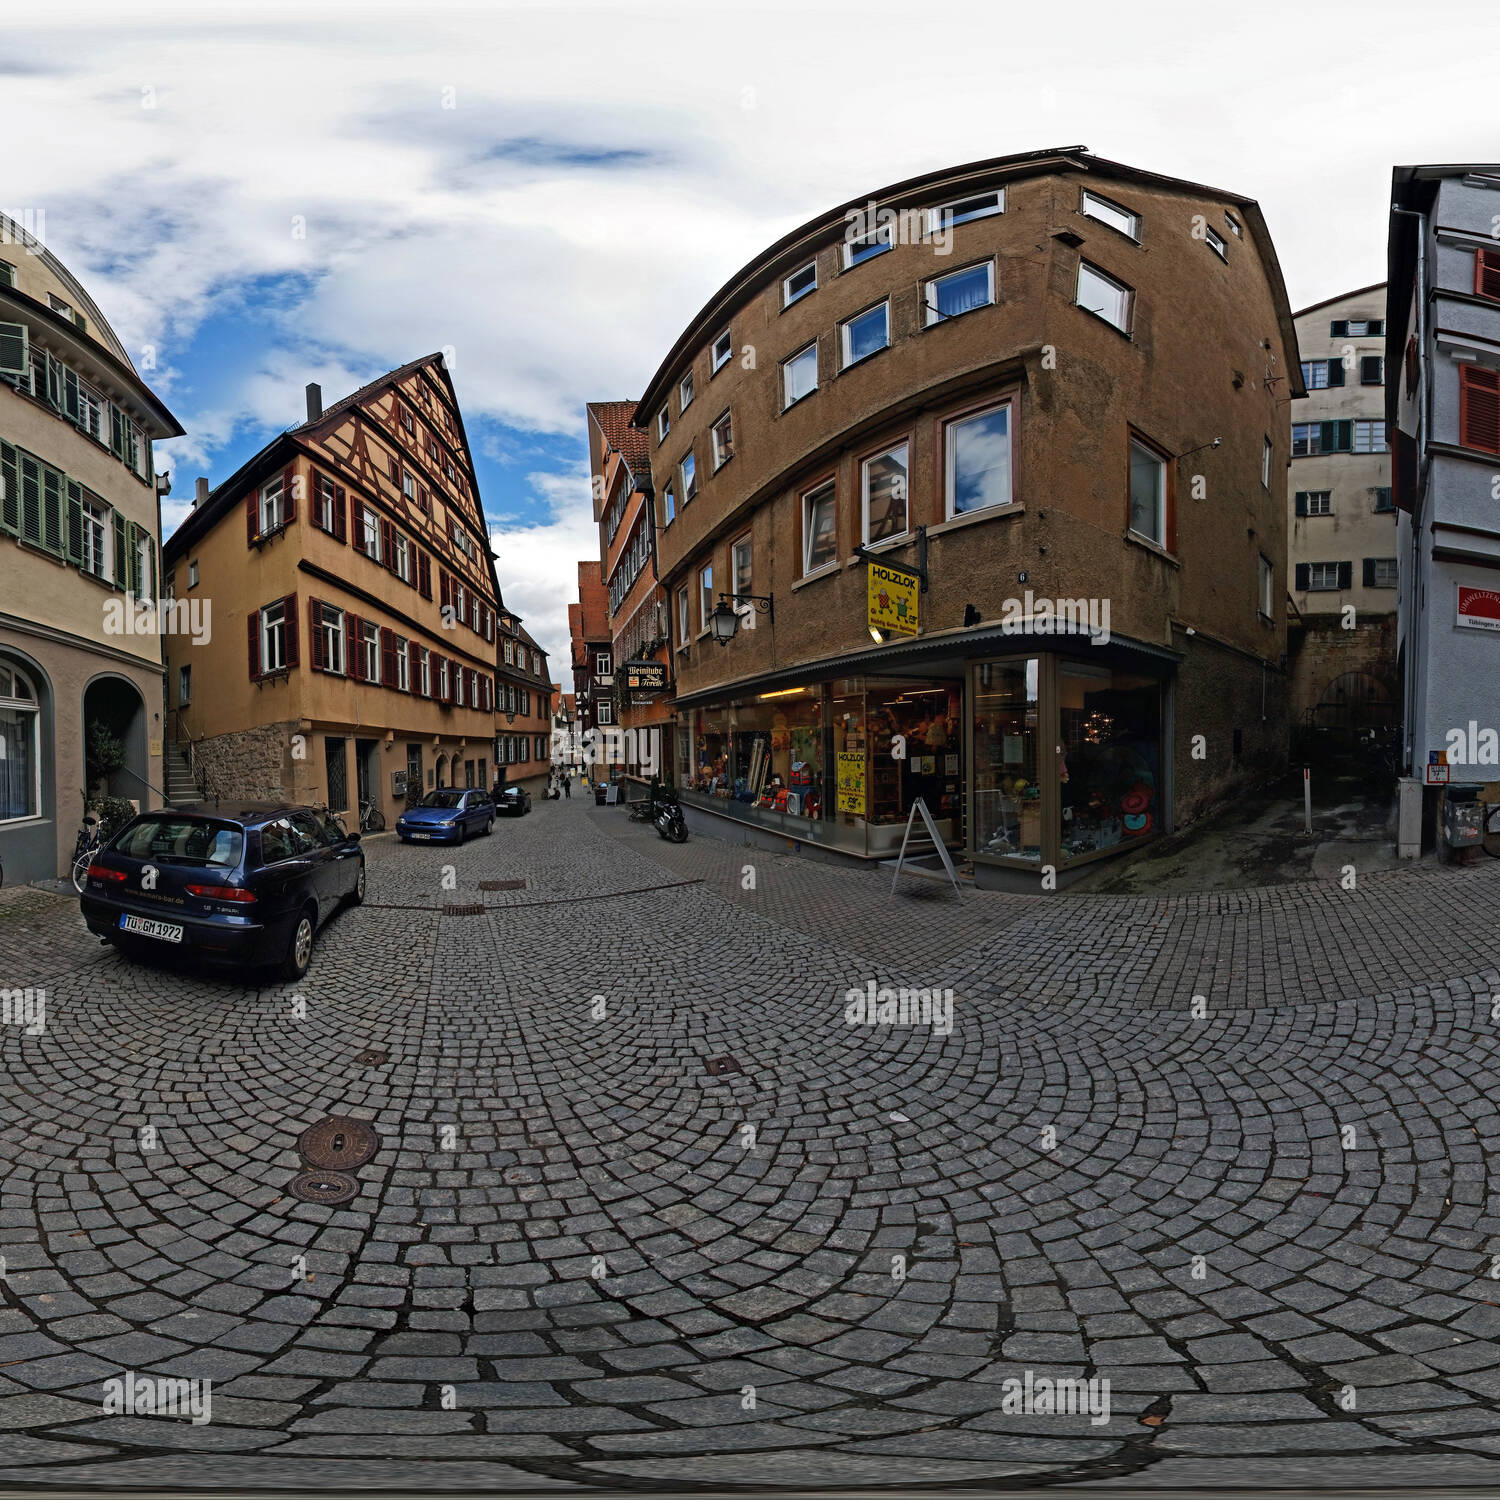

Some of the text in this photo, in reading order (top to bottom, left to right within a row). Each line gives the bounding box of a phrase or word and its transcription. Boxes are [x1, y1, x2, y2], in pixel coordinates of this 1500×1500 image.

[872, 566, 916, 590] HOLZLOK
[126, 916, 181, 939] TÜ GM 1972
